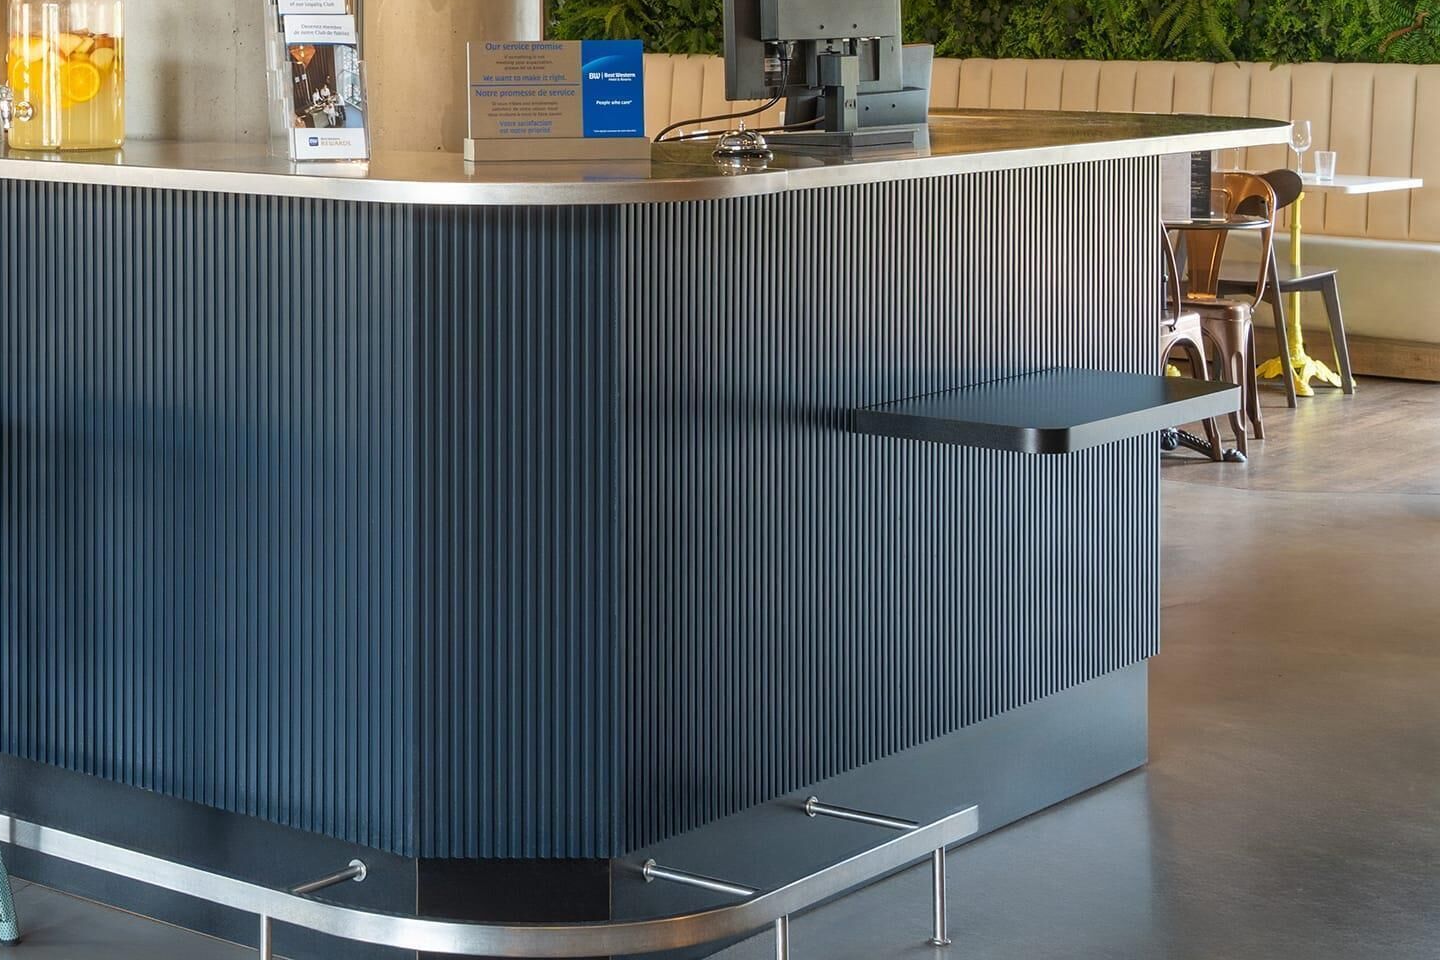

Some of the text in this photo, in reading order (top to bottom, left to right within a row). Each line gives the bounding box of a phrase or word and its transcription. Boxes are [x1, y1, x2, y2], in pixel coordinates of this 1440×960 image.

[486, 43, 563, 51] Our service promise
